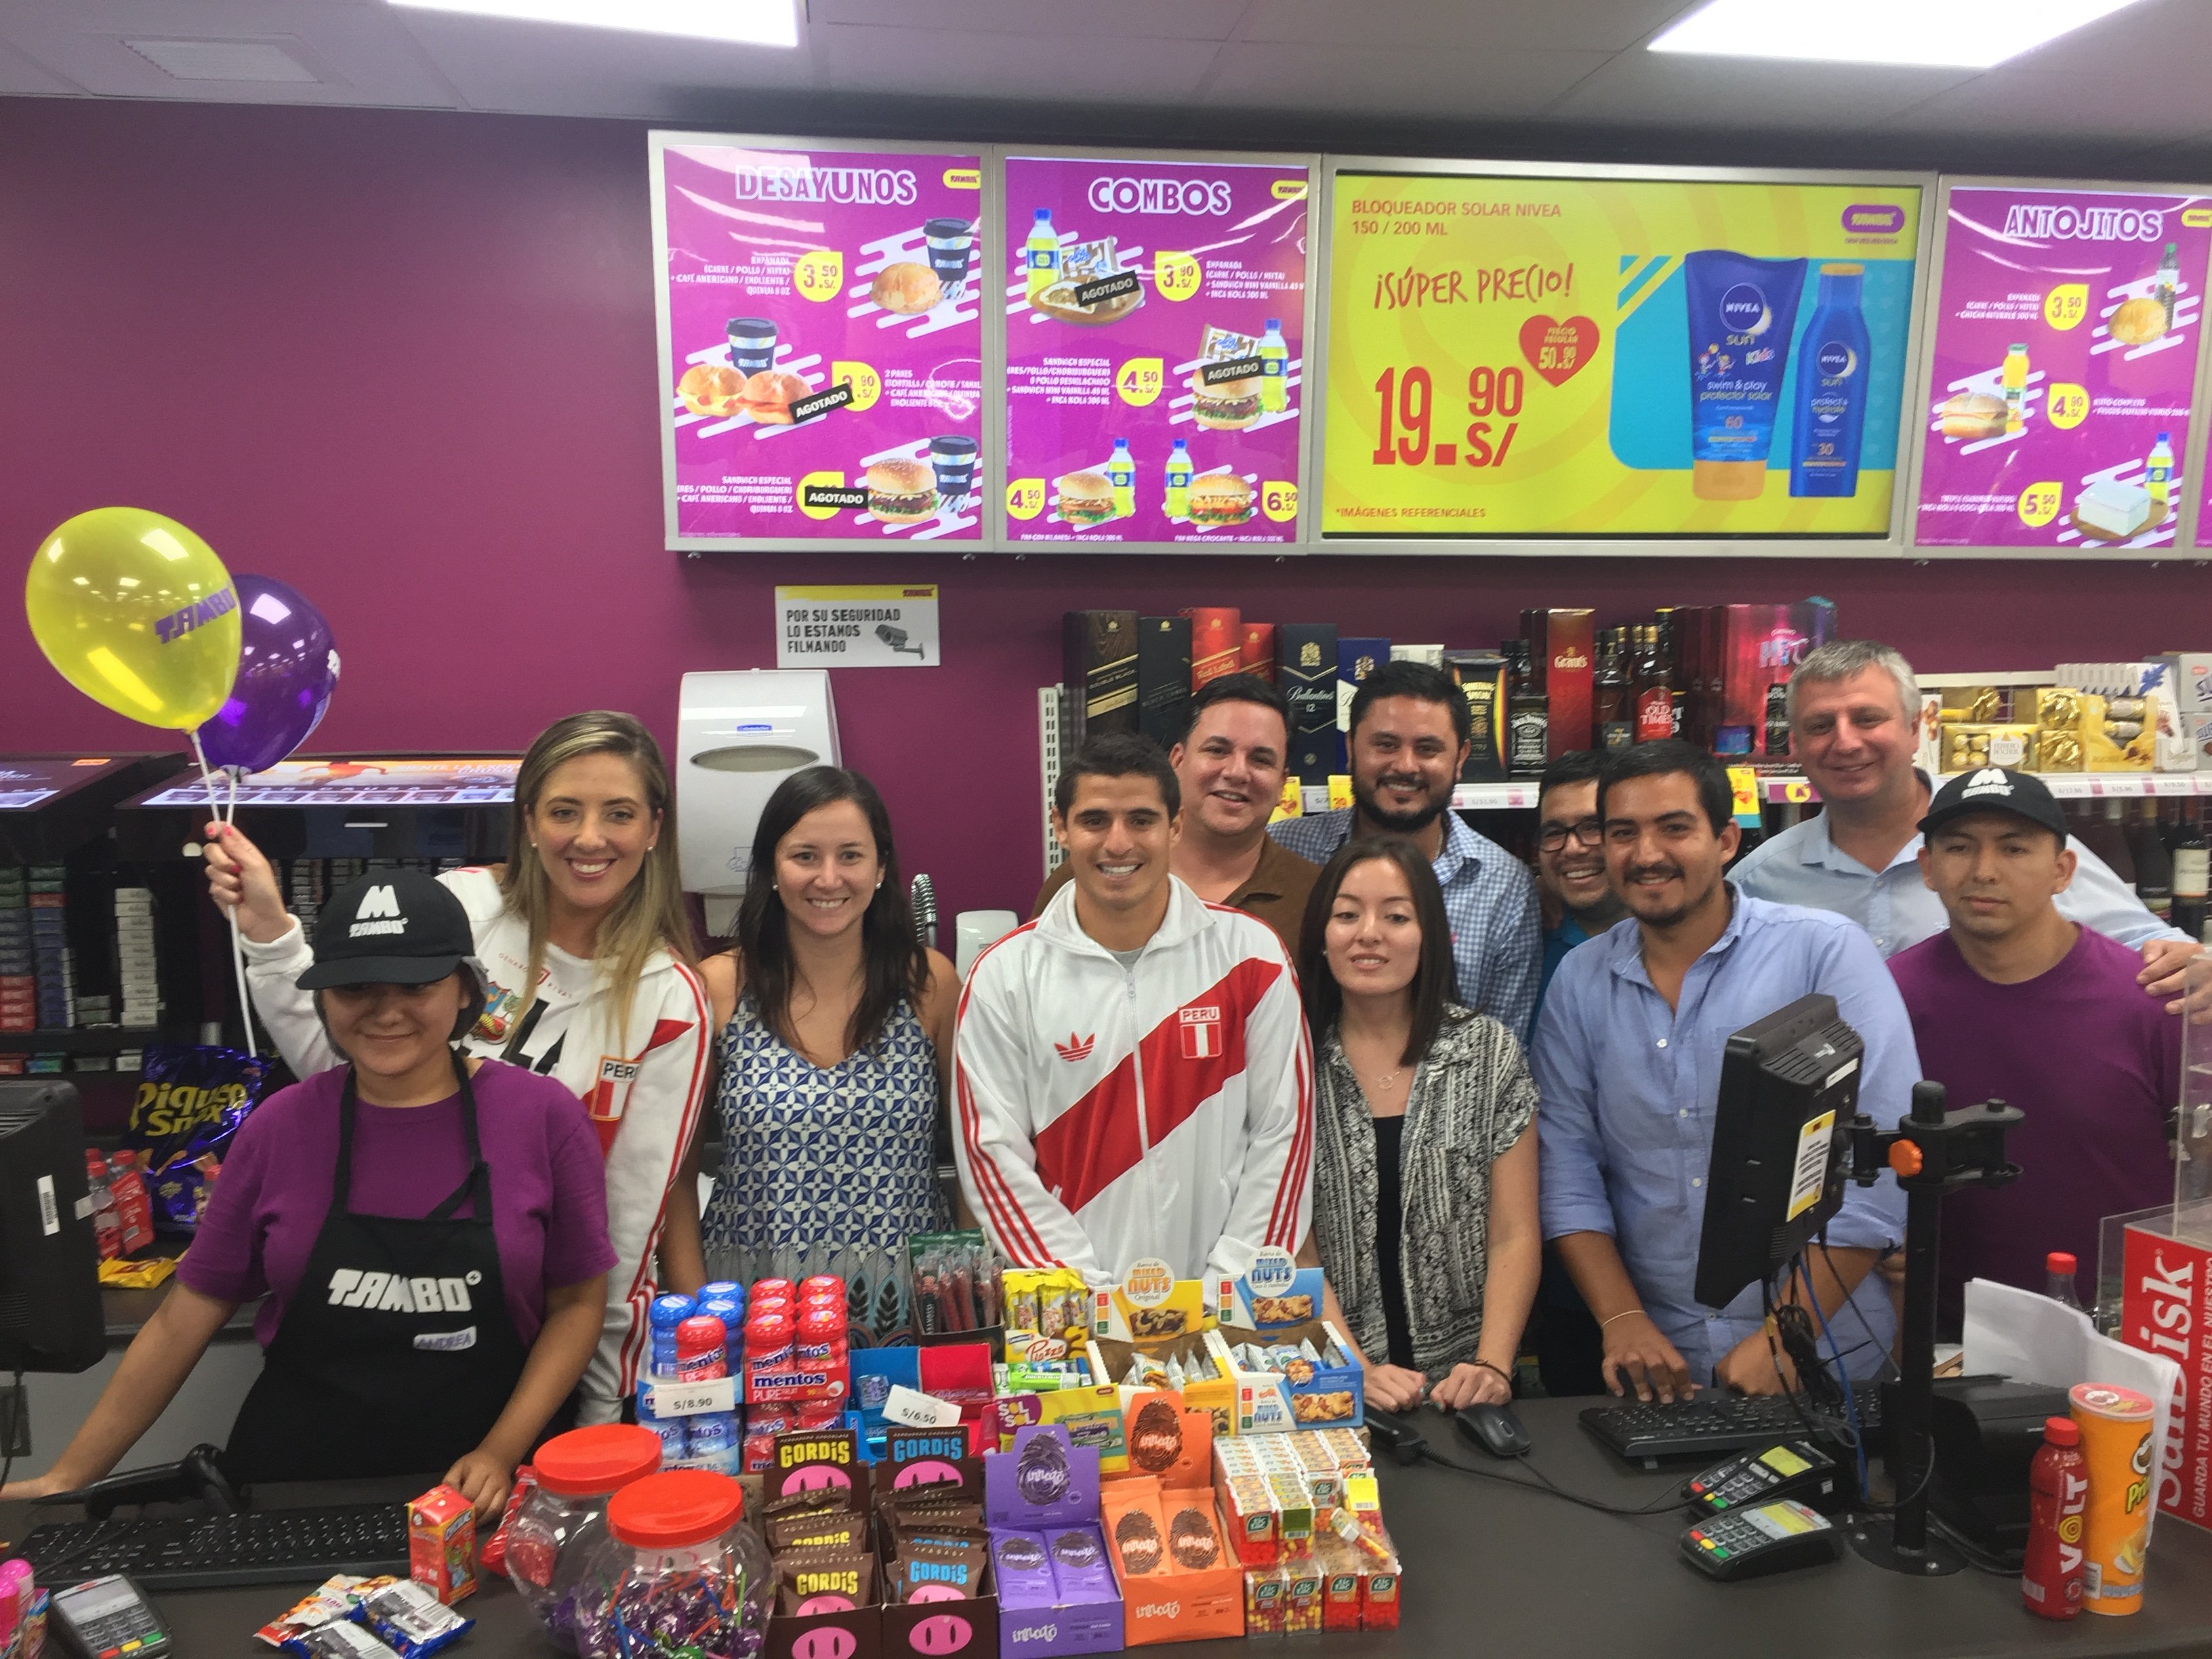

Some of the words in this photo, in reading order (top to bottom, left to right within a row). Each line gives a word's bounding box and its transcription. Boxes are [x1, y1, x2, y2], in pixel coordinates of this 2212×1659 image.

[735, 165, 917, 205] DESAYUNOS
[1088, 176, 1231, 216] COMBOS
[1352, 201, 1456, 218] BLOQUEADOR
[1461, 202, 1510, 217] SOLAR
[1515, 204, 1561, 218] NIVEA
[1352, 220, 1378, 234] 150
[1393, 221, 1421, 235] 200
[1425, 222, 1448, 236] ML
[2003, 205, 2163, 242] ANTOJITOS
[736, 266, 760, 274] POLLO
[821, 265, 838, 276] 50
[1081, 278, 1134, 302] AGOTADO
[1477, 262, 1574, 304] PRECIO!
[1725, 302, 1760, 314] NIVEA
[2068, 297, 2082, 308] 50
[1143, 371, 1158, 382] 50
[1207, 361, 1260, 382] AGOTADO
[1468, 366, 1523, 417] 90
[1707, 380, 1734, 390] swim
[796, 390, 848, 418] AGOTADO
[1465, 422, 1519, 468] S/
[808, 492, 864, 505] AGOTADO
[1027, 490, 1041, 499] 50
[1284, 492, 1298, 502] 50
[1401, 508, 1486, 518] REFERENCIALES
[787, 609, 809, 622] POR
[812, 609, 828, 622] SU
[831, 609, 901, 622] SEGURIDAD
[787, 626, 801, 638] LO
[804, 625, 861, 638] ESTAMOS
[787, 640, 847, 653] FILMANDO
[1306, 703, 1316, 713] 12
[1645, 705, 1672, 716] OLD
[348, 919, 405, 939] TAMBO
[1182, 1008, 1217, 1021] PERU
[145, 1107, 224, 1137] Snax
[1132, 1267, 1166, 1277] MIXED
[327, 1268, 472, 1313] TAMBO
[2201, 1330, 2212, 1349] EL
[2200, 1351, 2212, 1374] EN
[754, 1373, 827, 1388] mentos
[673, 1397, 713, 1411] S/8.90
[753, 1390, 781, 1402] PURE
[2197, 1376, 2212, 1430] MUNDO
[900, 1407, 937, 1425] S/6.50
[2196, 1432, 2210, 1452] TU
[2191, 1456, 2209, 1519] GUARDA
[2059, 1473, 2088, 1575] VOLT
